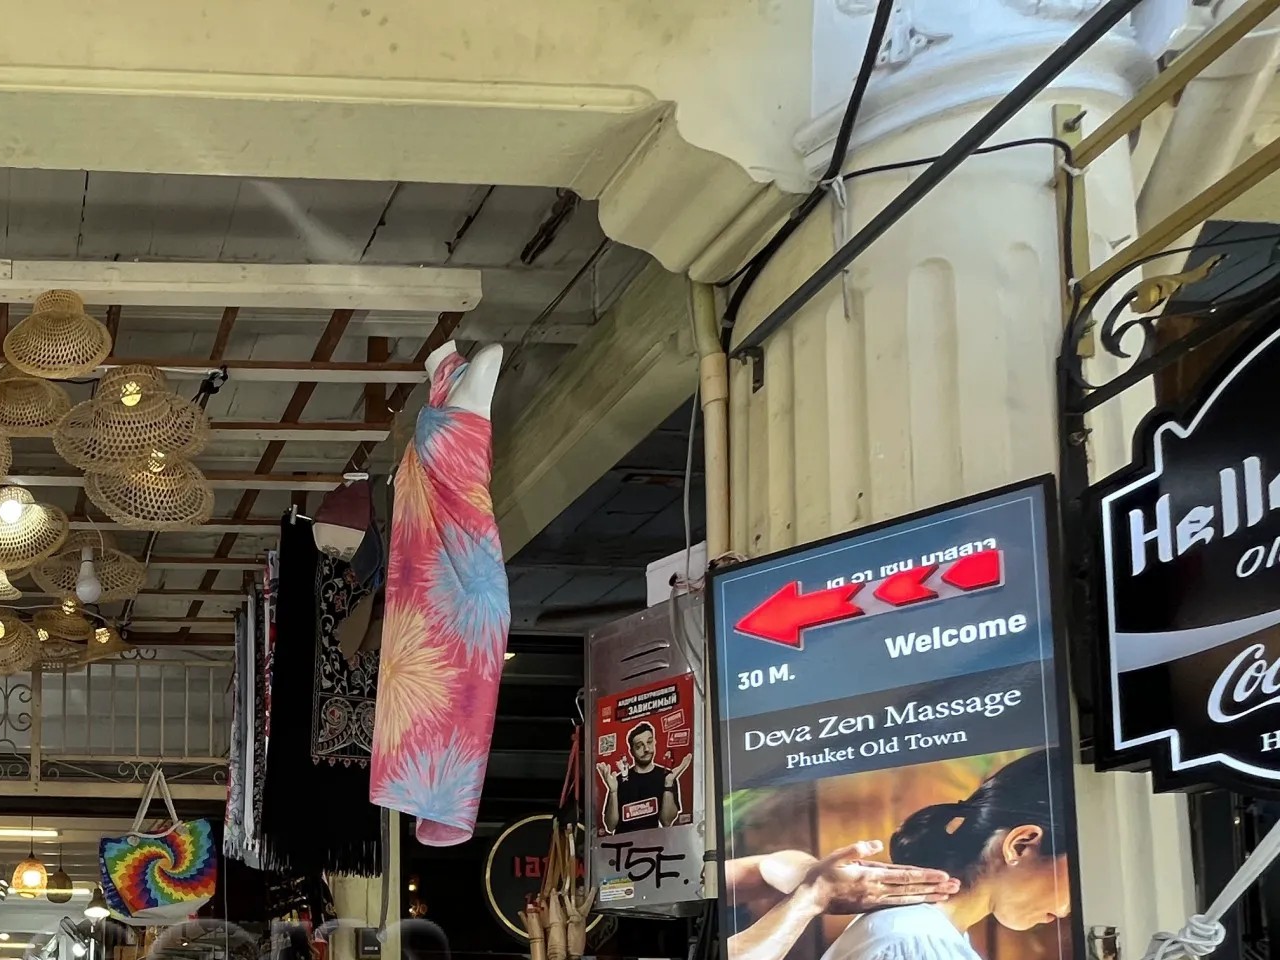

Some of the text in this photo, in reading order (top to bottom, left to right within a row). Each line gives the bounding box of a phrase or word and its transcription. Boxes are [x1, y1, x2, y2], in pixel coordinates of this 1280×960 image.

[885, 612, 1027, 659] Welcome
[738, 664, 796, 690] 30 M.
[745, 689, 1022, 751] Deva Zen Massage
[786, 731, 967, 769] Phuket Old Town
